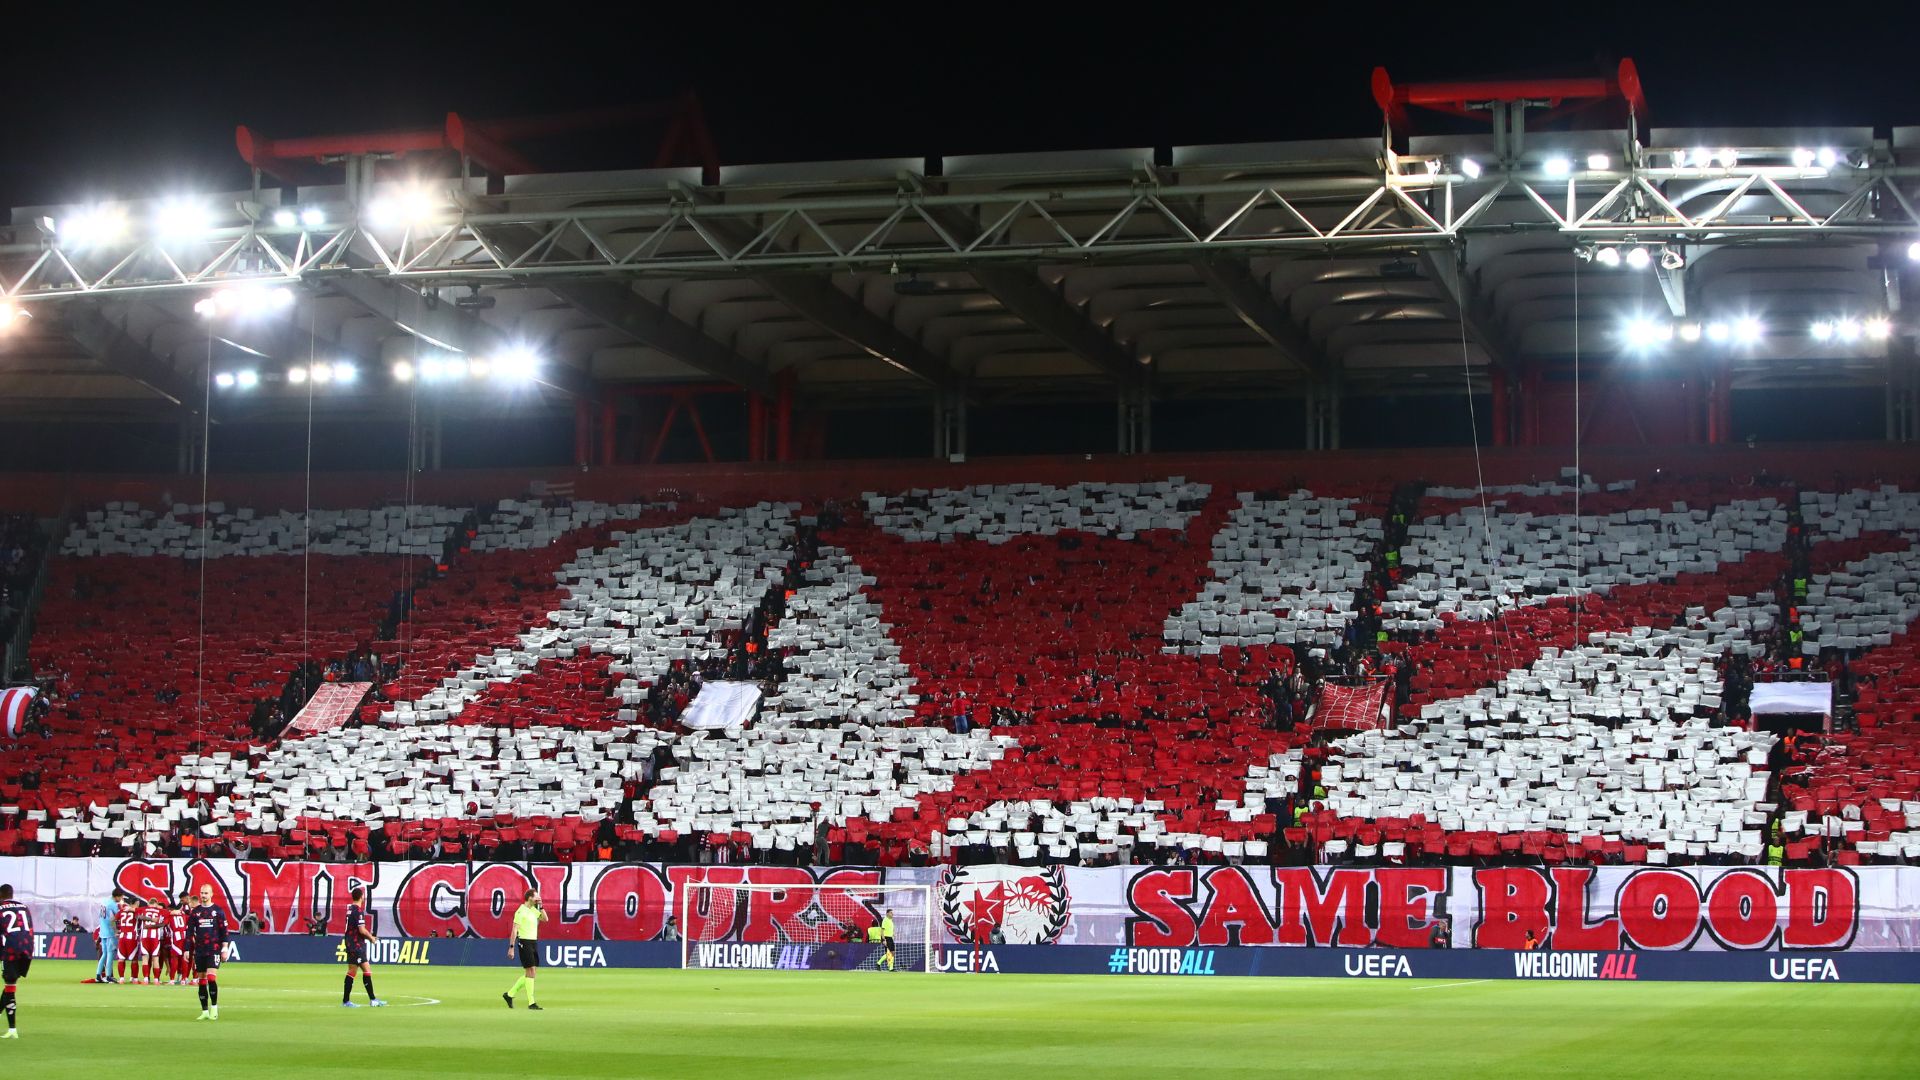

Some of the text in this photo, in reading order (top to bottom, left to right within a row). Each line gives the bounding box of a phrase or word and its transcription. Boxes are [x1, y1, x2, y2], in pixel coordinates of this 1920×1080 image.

[114, 860, 886, 942] SAME COLOURS
[1125, 865, 1860, 951] SAME BLOOD
[2, 910, 30, 933] 21
[120, 912, 134, 926] 22
[173, 915, 185, 928] 10
[47, 935, 77, 958] ALL
[335, 939, 429, 964] #OOTBALL
[545, 946, 607, 967] UEFA
[698, 943, 811, 969] WELCOME ALL
[934, 950, 1000, 972] UEFA
[1108, 948, 1215, 974] #FOOTBALL
[1344, 954, 1413, 977] UEFA
[1514, 952, 1637, 979] WELCOME ALL
[1769, 958, 1840, 981] UEFA
